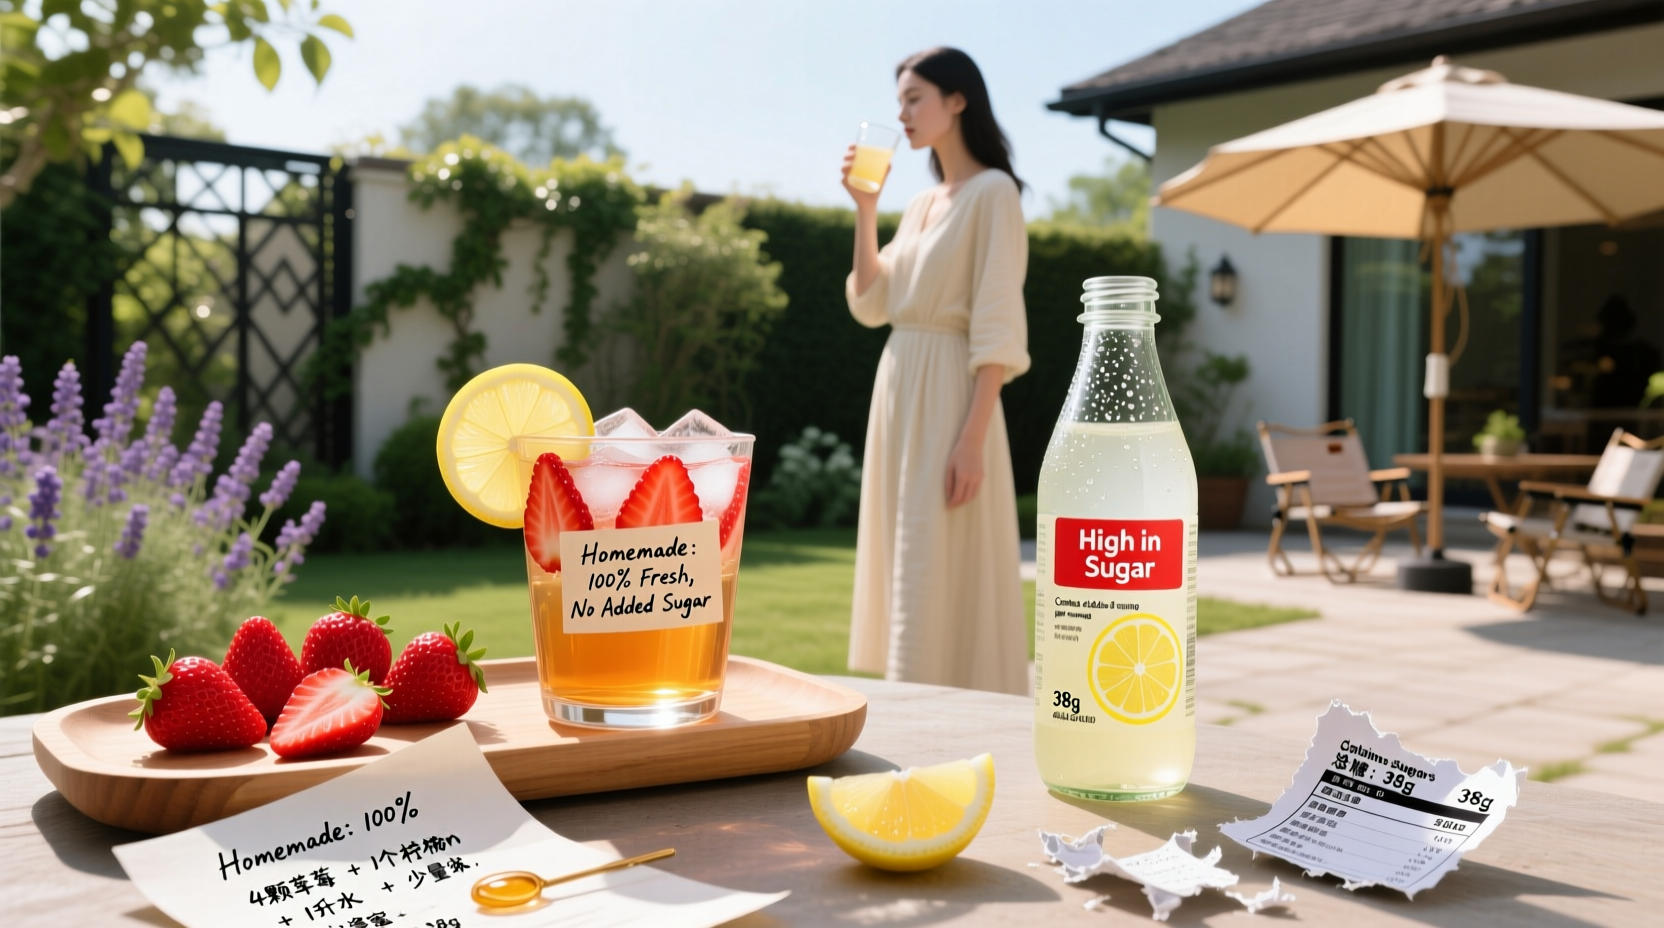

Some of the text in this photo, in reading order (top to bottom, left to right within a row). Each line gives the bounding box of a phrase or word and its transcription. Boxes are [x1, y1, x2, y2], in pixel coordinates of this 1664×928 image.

[581, 536, 696, 566] Homemade:
[1079, 528, 1161, 558] High in
[588, 563, 694, 591] 100% Fresh,
[1084, 555, 1156, 584] Sugar
[570, 593, 712, 619] No Added Sugar
[1052, 690, 1081, 714] 38g
[1457, 788, 1495, 813] 38g
[218, 791, 419, 881] Homemade: 100%
